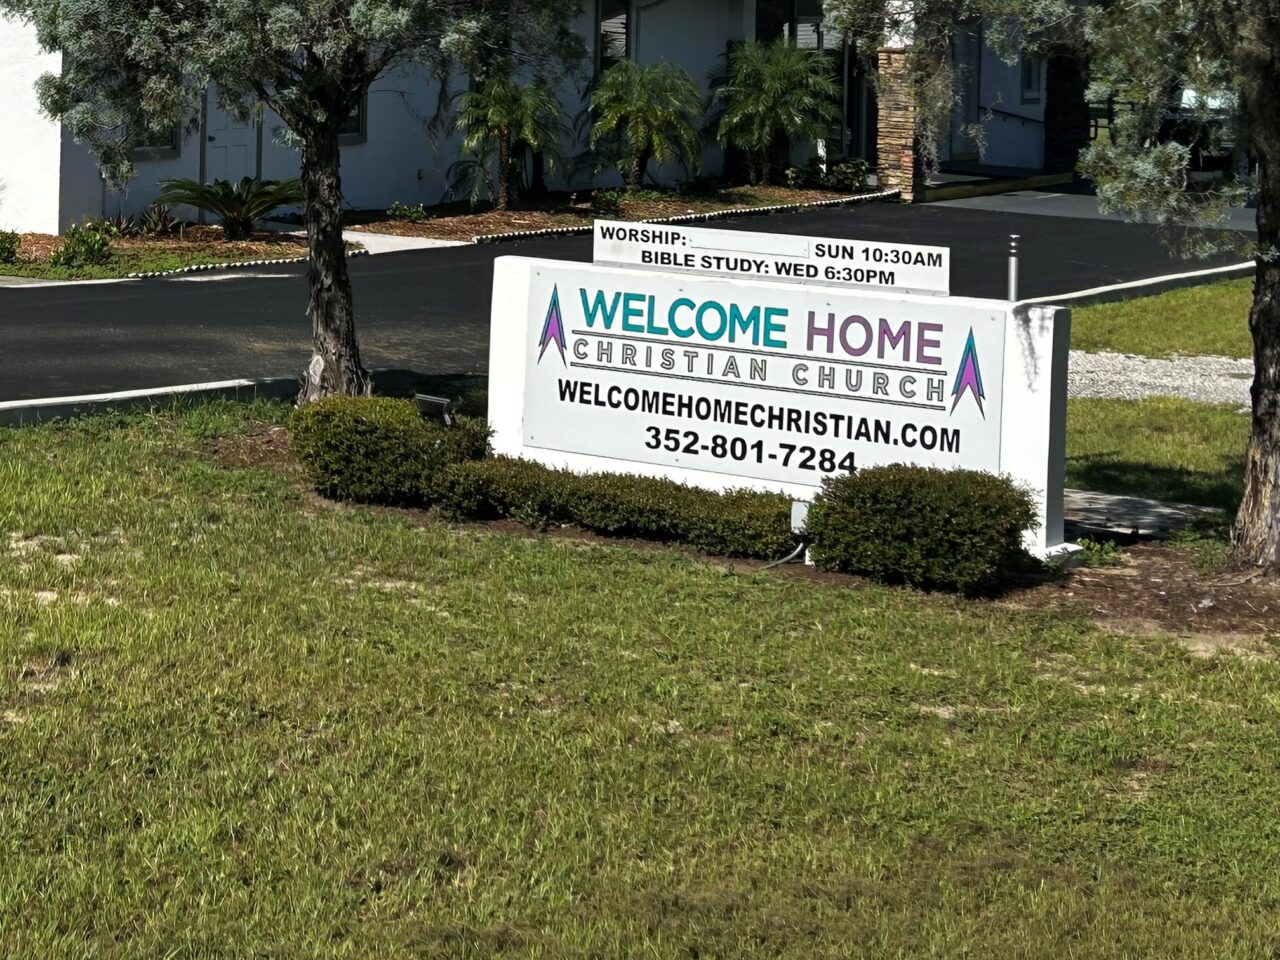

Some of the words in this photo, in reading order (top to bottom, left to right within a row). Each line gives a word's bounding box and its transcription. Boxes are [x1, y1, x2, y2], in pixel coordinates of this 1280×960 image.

[600, 226, 687, 246] WORSHIP:
[814, 243, 855, 260] SUN
[862, 246, 943, 268] 10:30AM
[641, 250, 695, 268] BIBLE
[701, 254, 769, 275] STUDY:
[774, 260, 819, 278] WED
[824, 266, 896, 285] 6:30PM
[579, 288, 788, 349] WELCOME
[806, 311, 944, 364] HOME
[574, 339, 767, 382] CHRISTIAN
[792, 364, 944, 402] CHURCH
[558, 379, 961, 454] WELCOMEHOMECHRISTIAN.COM
[645, 426, 858, 475] 352-801-7284
